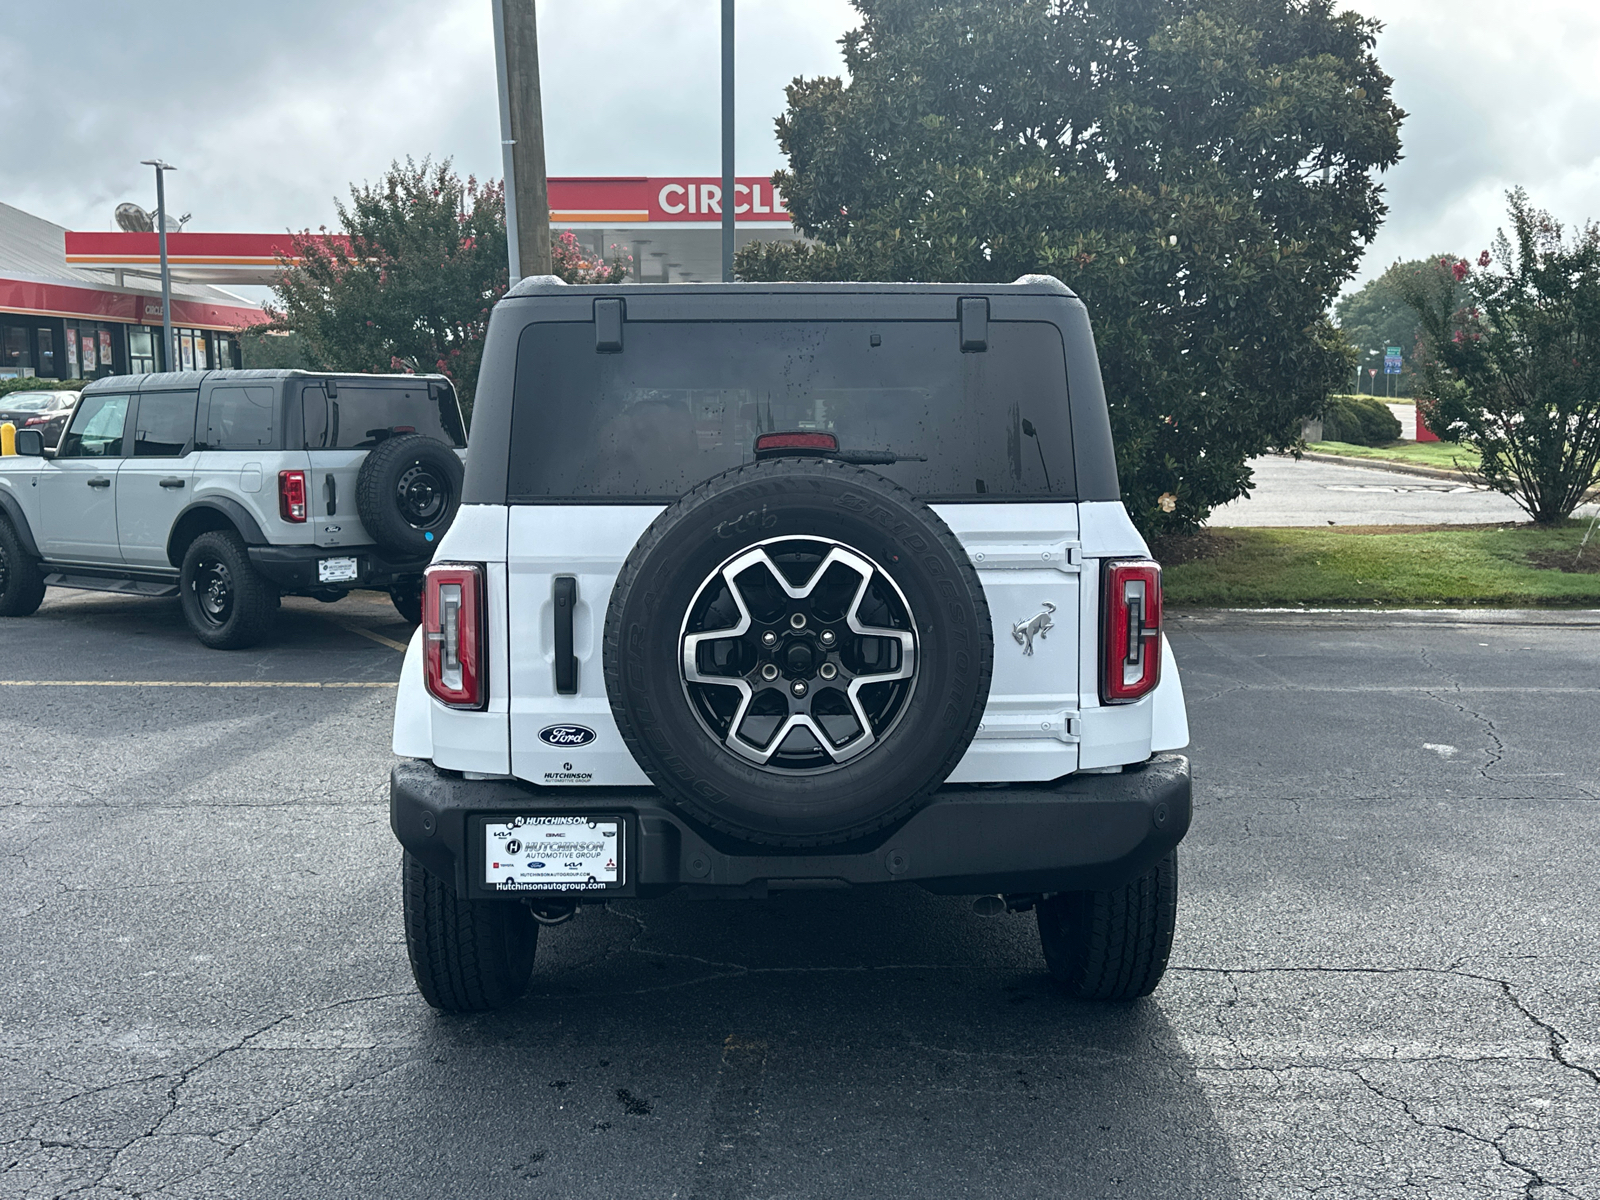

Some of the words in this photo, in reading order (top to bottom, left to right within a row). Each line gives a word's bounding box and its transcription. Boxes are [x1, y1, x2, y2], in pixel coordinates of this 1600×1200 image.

[834, 490, 970, 731] BRIDGESTONE
[626, 622, 731, 804] DUELER
[549, 728, 585, 743] Ford
[526, 816, 588, 825] HUTCHINSON
[524, 841, 605, 852] HUTCHINSON
[496, 882, 606, 891] Hutchinsonautogroup.com
